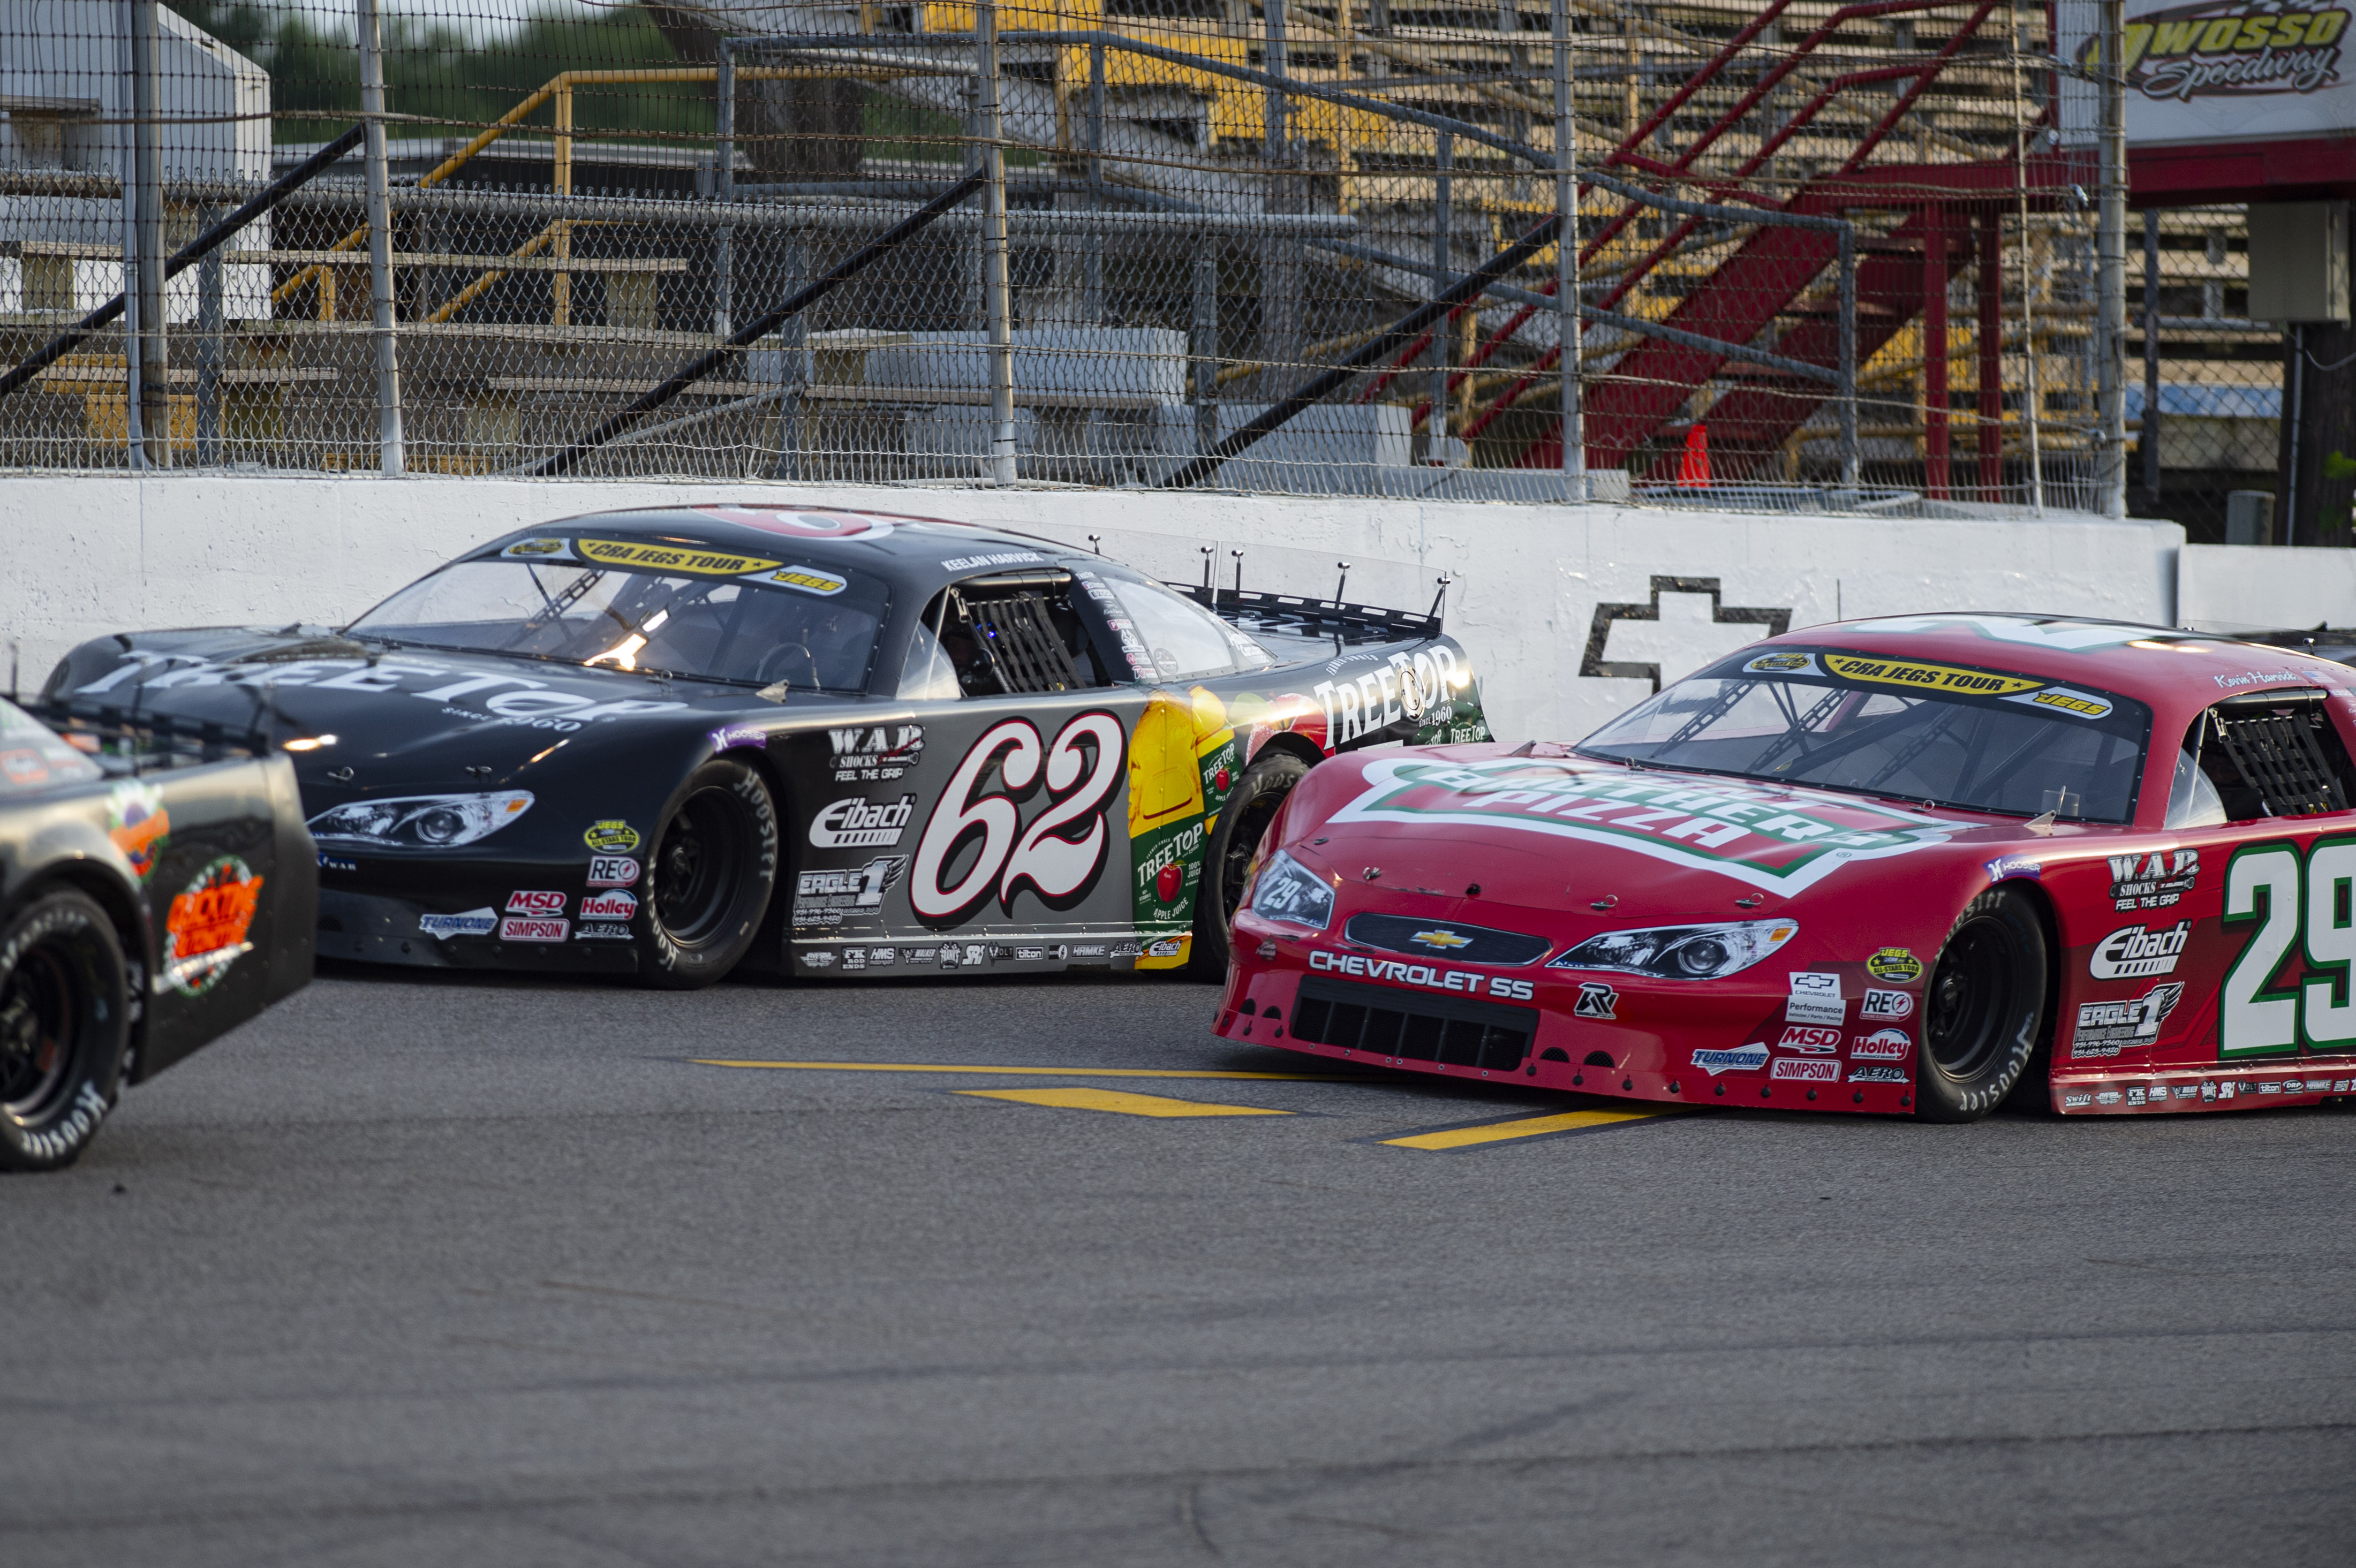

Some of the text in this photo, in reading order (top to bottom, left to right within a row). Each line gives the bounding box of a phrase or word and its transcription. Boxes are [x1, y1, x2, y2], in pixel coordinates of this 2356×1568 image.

[2142, 46, 2339, 102] Speedway
[591, 542, 746, 571] CRA JEGS TOUR
[941, 550, 1045, 572] KEELAN HARVICK
[772, 570, 844, 591] JEGS
[1839, 660, 2005, 692] CRA JEGS TOUR
[2213, 674, 2251, 688] Kevin
[410, 671, 689, 721] TOP
[1313, 645, 1458, 751] TREE TOP
[2034, 692, 2109, 716] JEGS
[442, 707, 583, 732] SINCE 1960
[1419, 718, 1431, 728] SINCE
[1431, 706, 1453, 726] 1960
[1471, 725, 1485, 741] TOP
[840, 755, 878, 768] SHOCKS
[1203, 756, 1224, 785] TREE
[1221, 743, 1235, 765] TOP
[835, 767, 904, 782] FEEL THE GRIP
[809, 795, 913, 848] Eibach
[910, 712, 1124, 918] 62
[1462, 790, 1753, 849] PIZZA
[1137, 822, 1204, 888] TREE TOP
[798, 860, 894, 906] EAGLE 1
[2119, 881, 2157, 897] SHOCKS
[507, 891, 565, 910] MSD
[1262, 876, 1303, 910] 29
[2115, 893, 2180, 911] FEEL THE GRIP
[582, 898, 636, 919] Holley
[1153, 897, 1189, 920] APPLE JUICE
[421, 915, 498, 930] TURNONE
[505, 921, 563, 938] SIMPSON
[579, 922, 630, 935] AERO
[844, 949, 865, 959] FK
[870, 948, 895, 959] HMS
[1017, 949, 1042, 958] tilton
[1114, 942, 1142, 953] AERO
[1149, 940, 1181, 957] Eibach
[1881, 948, 1909, 958] JEGS
[2089, 921, 2190, 980] Eibach
[2221, 835, 2356, 1058] 29
[1309, 950, 1485, 992] CHEVROLET
[1489, 976, 1534, 1001] SS
[1874, 964, 1920, 974] ALL-STARS TOUR
[1795, 989, 1837, 998] CHEVROLET
[1789, 1002, 1844, 1014] Performance
[2078, 988, 2170, 1037] EAGLE 1
[1780, 1027, 1841, 1048] MSD
[1853, 1037, 1908, 1059] Holley
[1693, 1051, 1769, 1065] TURNONE
[1776, 1061, 1834, 1080] SIMPSON
[1852, 1066, 1905, 1080] AERO
[2065, 1093, 2092, 1103] Swift
[2128, 1088, 2145, 1096] FK
[2149, 1087, 2168, 1096] HMS
[2260, 1084, 2280, 1093] tilton
